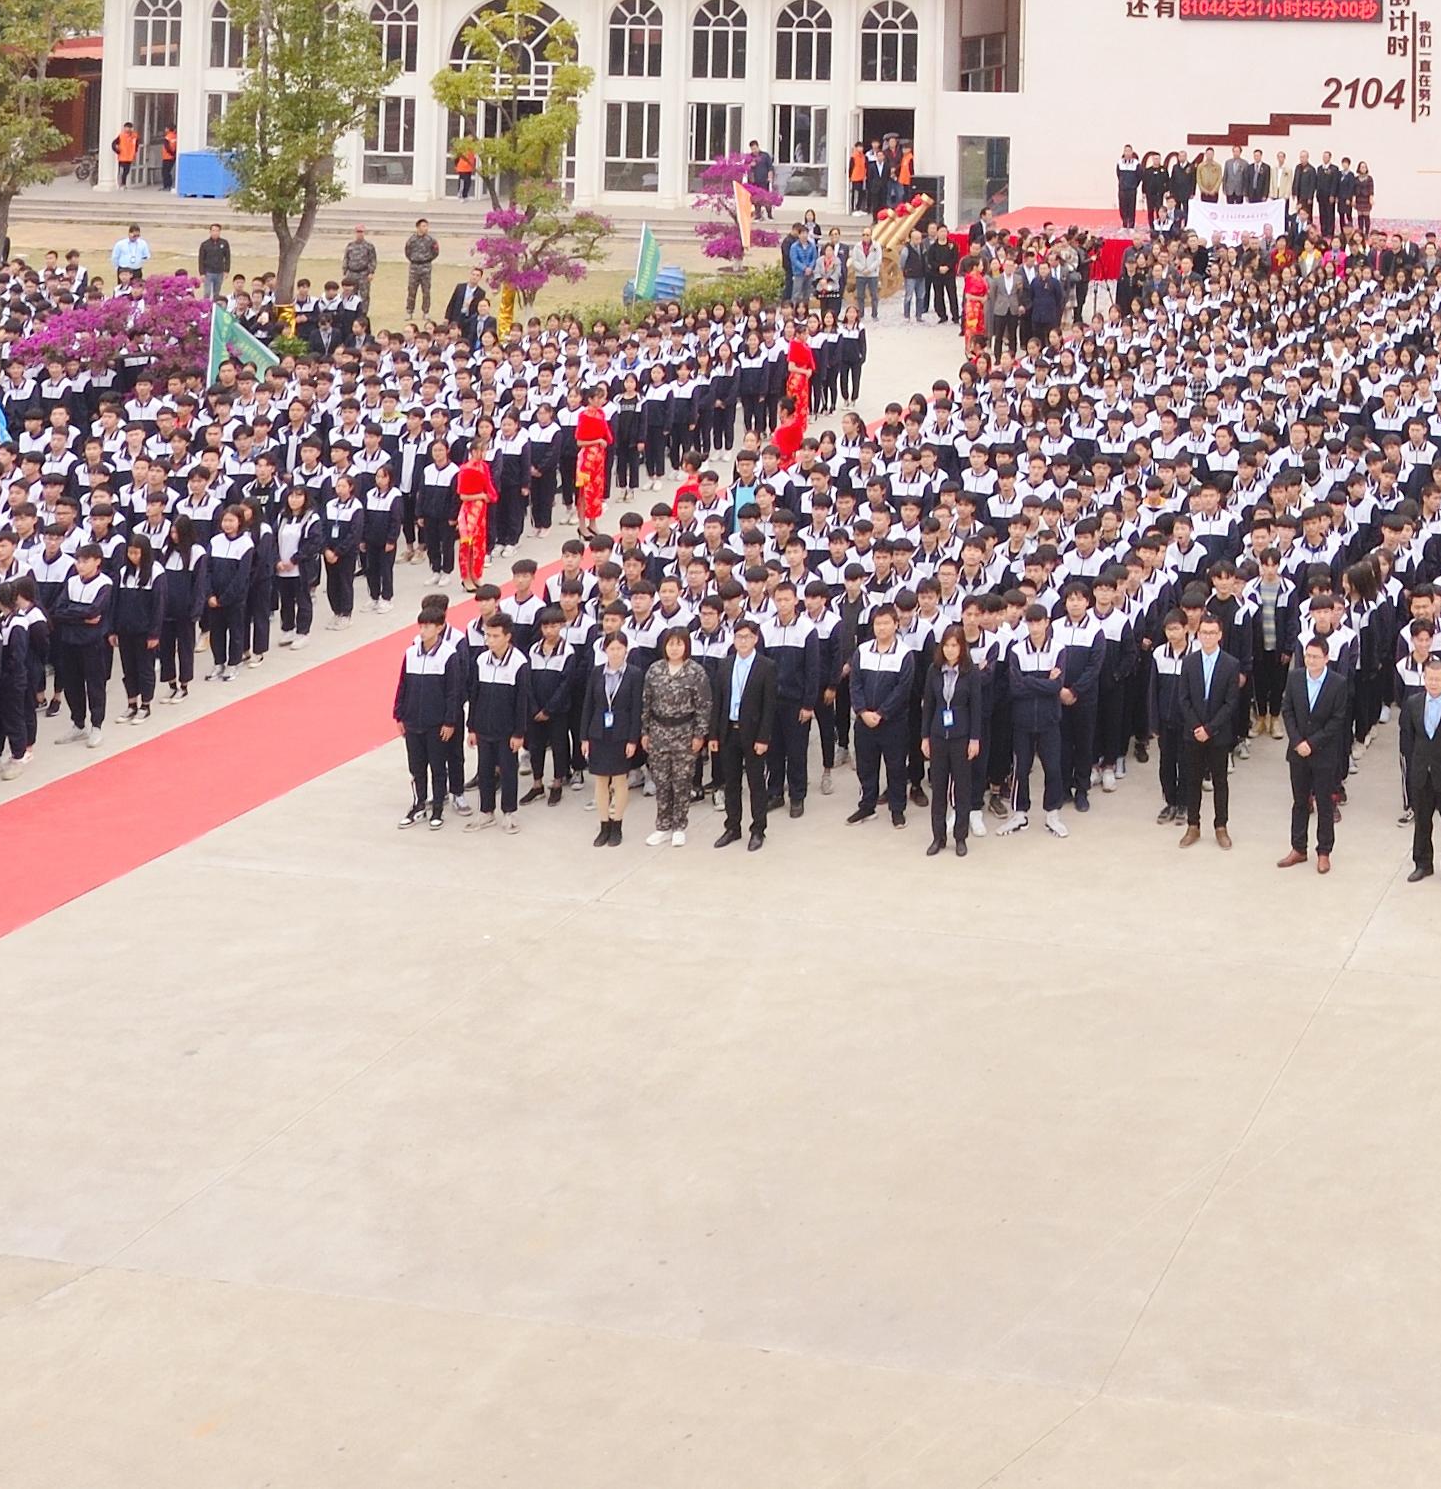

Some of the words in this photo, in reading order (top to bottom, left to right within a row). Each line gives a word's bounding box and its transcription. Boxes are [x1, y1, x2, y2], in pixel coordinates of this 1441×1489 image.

[1321, 78, 1406, 109] 2104
[1418, 21, 1432, 117] 我们一直在努力
